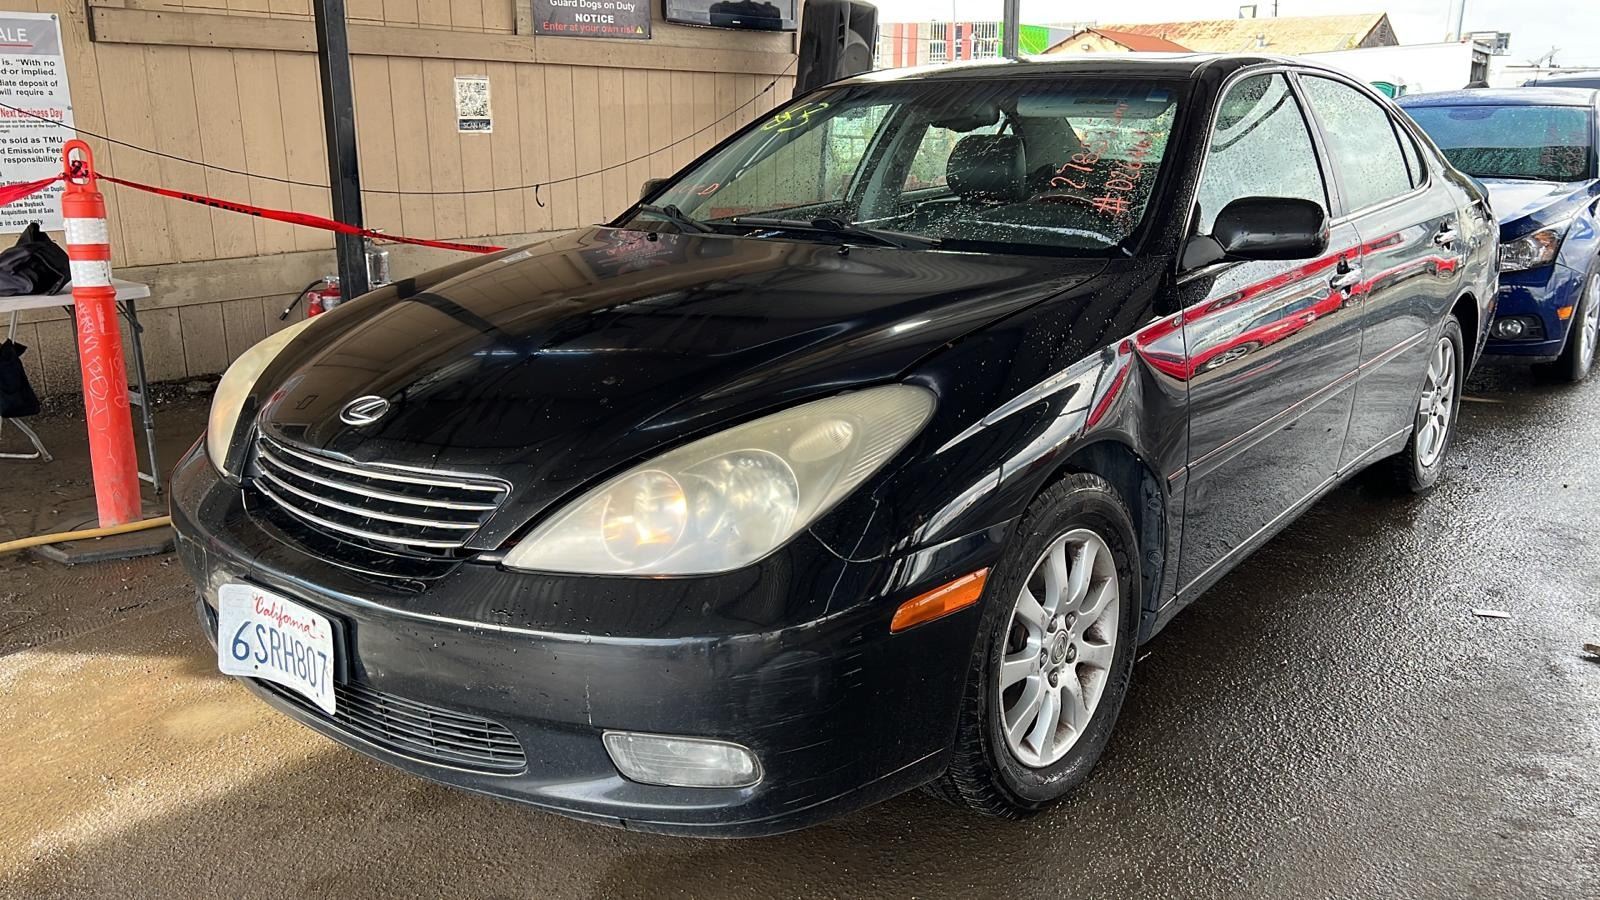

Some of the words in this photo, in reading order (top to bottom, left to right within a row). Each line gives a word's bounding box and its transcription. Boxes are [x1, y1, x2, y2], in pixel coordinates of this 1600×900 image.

[580, 0, 602, 10] Dogs
[616, 1, 635, 12] Duty
[575, 13, 614, 23] NOTICE
[543, 21, 567, 31] Enter
[569, 22, 578, 31] at
[580, 24, 598, 33] your
[620, 25, 635, 33] risk
[19, 80, 48, 88] deposit
[16, 88, 44, 97] require
[1, 107, 17, 118] Next
[50, 107, 63, 119] Day
[255, 596, 317, 639] California
[232, 620, 327, 696] 6SRH807
